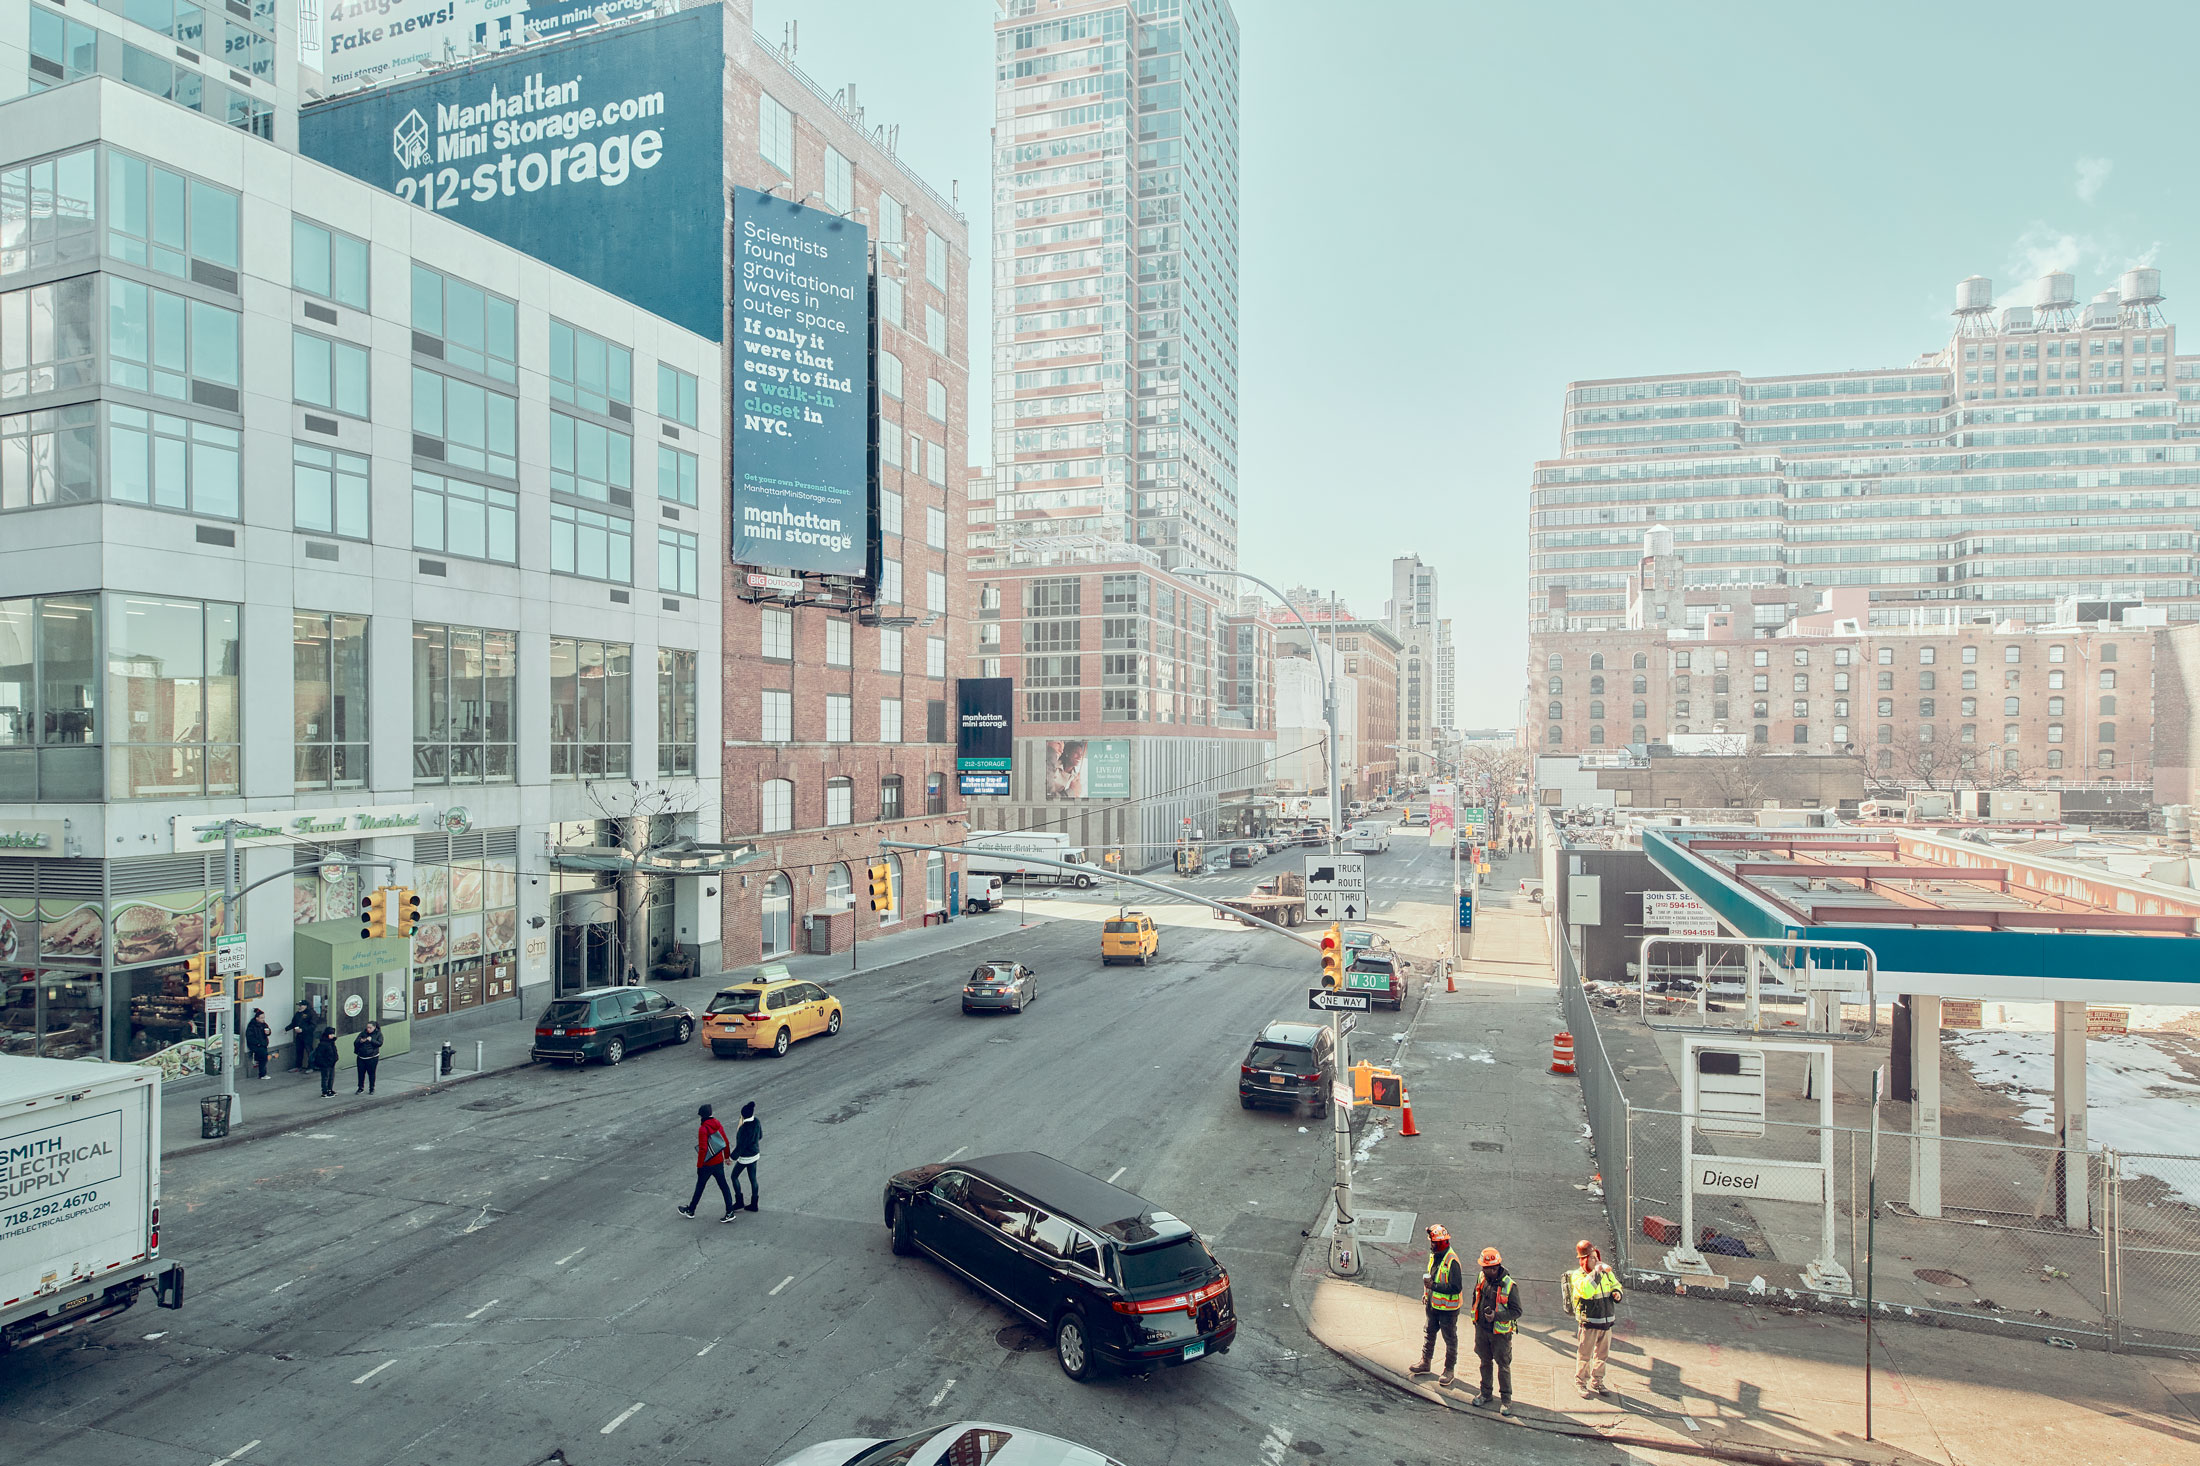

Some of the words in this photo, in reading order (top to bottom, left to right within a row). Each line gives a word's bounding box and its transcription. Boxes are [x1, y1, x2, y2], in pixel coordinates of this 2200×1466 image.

[330, 28, 384, 54] Fake
[389, 2, 454, 38] news!
[562, 8, 592, 25] mini
[332, 71, 353, 84] Mini
[354, 63, 391, 79] storage.
[437, 121, 488, 163] Mini
[493, 91, 665, 150] Storage.com
[744, 221, 828, 258] Scientists
[744, 240, 795, 267] found
[743, 261, 854, 301] gravitational
[743, 280, 800, 304] waves
[805, 292, 819, 309] in
[743, 298, 791, 319] outer
[796, 311, 849, 334] space.
[744, 317, 761, 335] If
[764, 324, 807, 349] only
[810, 334, 825, 351] it
[744, 340, 792, 361] were
[795, 352, 834, 371] that
[744, 360, 789, 383] easy
[792, 368, 811, 385] to
[814, 372, 852, 393] find
[744, 379, 757, 392] a
[760, 383, 835, 408] walk-in
[744, 397, 800, 420] closet
[804, 407, 823, 425] in
[744, 414, 793, 438] NYC.
[744, 473, 758, 481] Get
[758, 476, 777, 484] your
[777, 479, 794, 487] own
[794, 481, 827, 492] Personal
[744, 483, 842, 505] ManhattanMiniStorage.com
[744, 502, 841, 533] manhattan
[744, 523, 782, 541] mini
[785, 525, 852, 552] storage
[750, 575, 766, 585] BIG
[767, 578, 801, 588] OUTDOOR
[962, 713, 1002, 721] manhattan
[979, 720, 1008, 729] storage
[296, 816, 348, 834] Food
[356, 813, 420, 830] Market
[1338, 864, 1362, 873] TRUCK
[1338, 878, 1362, 887] ROUTE
[1309, 892, 1333, 901] LOCAL
[1341, 892, 1360, 901] THRU
[527, 939, 546, 953] ohm
[219, 954, 245, 964] SHARED
[223, 962, 241, 970] LANE
[1350, 974, 1360, 986] W
[1362, 975, 1377, 988] 30
[1320, 995, 1339, 1005] ONE
[1343, 996, 1363, 1007] WAY
[0, 1136, 62, 1165] SMITH
[0, 1141, 113, 1182] ELECTRICAL
[0, 1168, 70, 1200] SUPPLY
[1702, 1169, 1759, 1190] Diesel
[0, 1201, 111, 1241] ITHELECTRICALSUPPLY.COM
[4, 1191, 97, 1228] 718.292.4670
